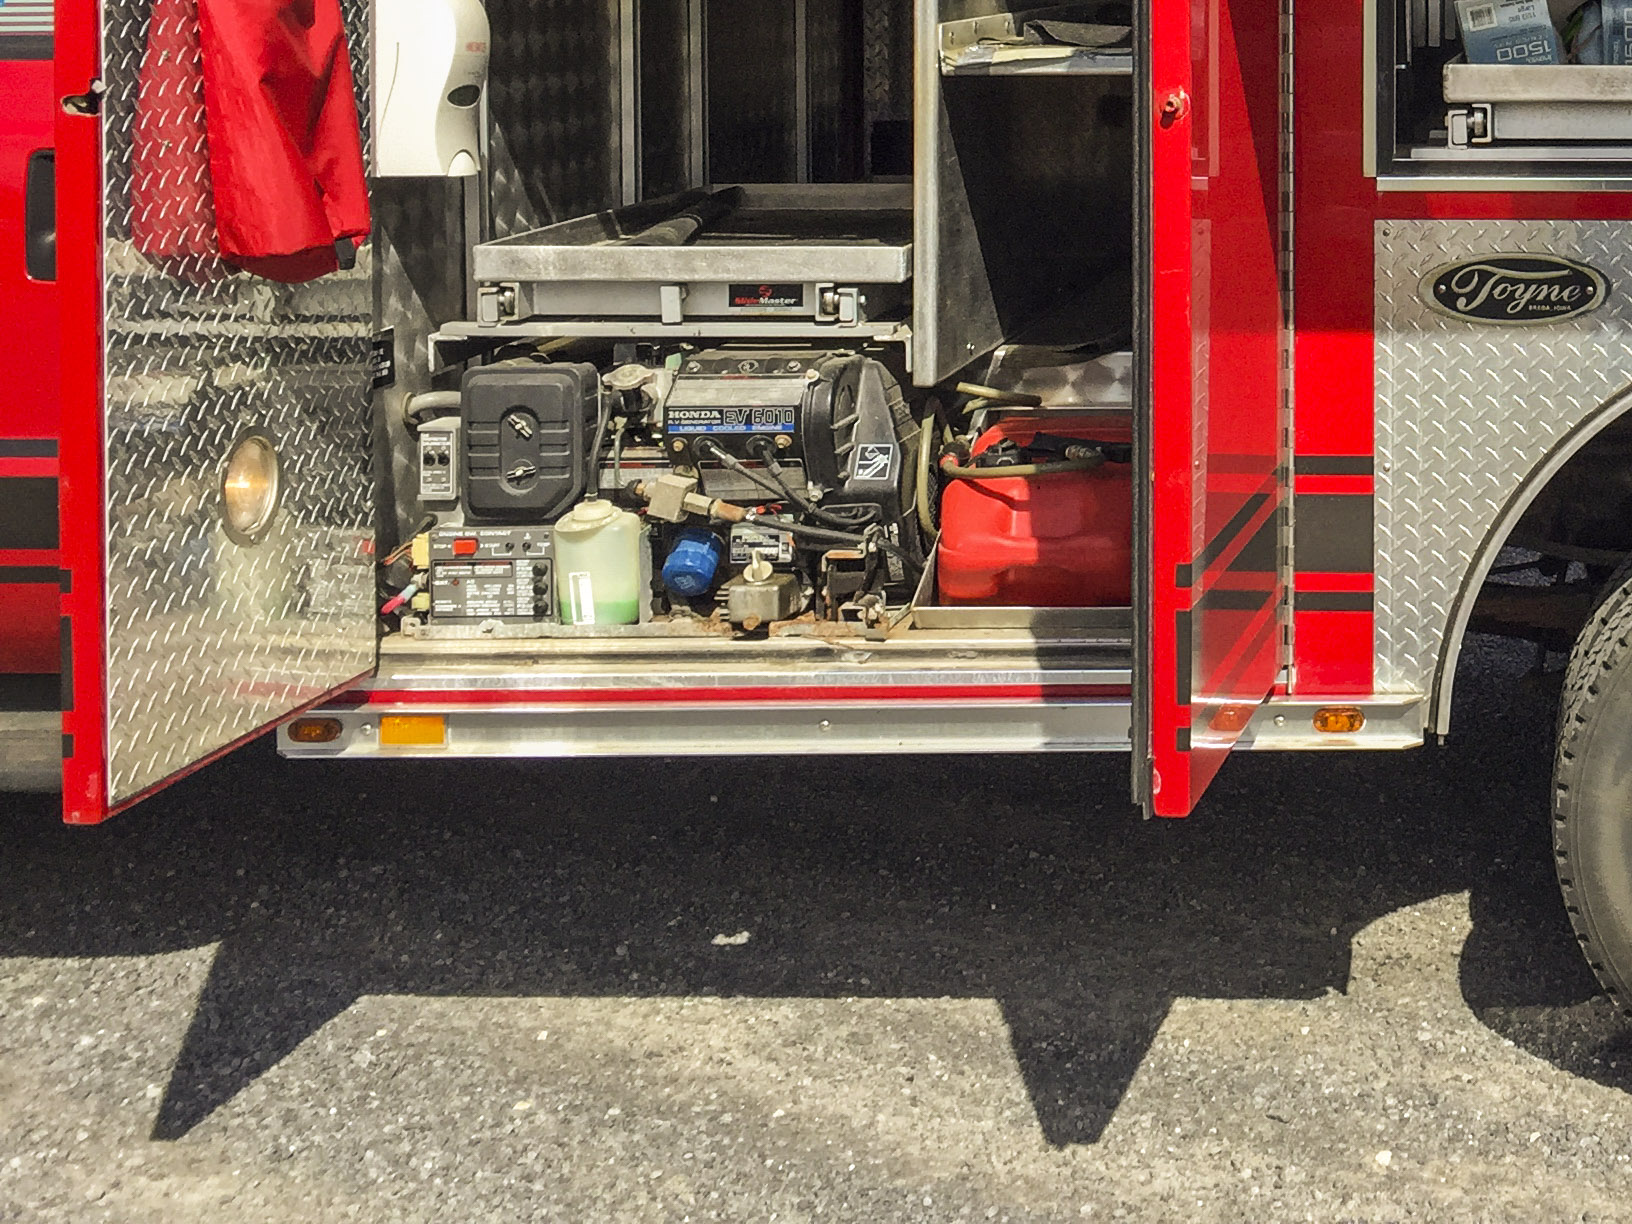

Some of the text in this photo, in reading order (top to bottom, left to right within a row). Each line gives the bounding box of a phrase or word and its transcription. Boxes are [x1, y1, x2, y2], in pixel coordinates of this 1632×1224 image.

[1496, 40, 1552, 62] 1500
[1450, 264, 1582, 314] Toyne
[667, 407, 795, 426] HONDA EV 6010
